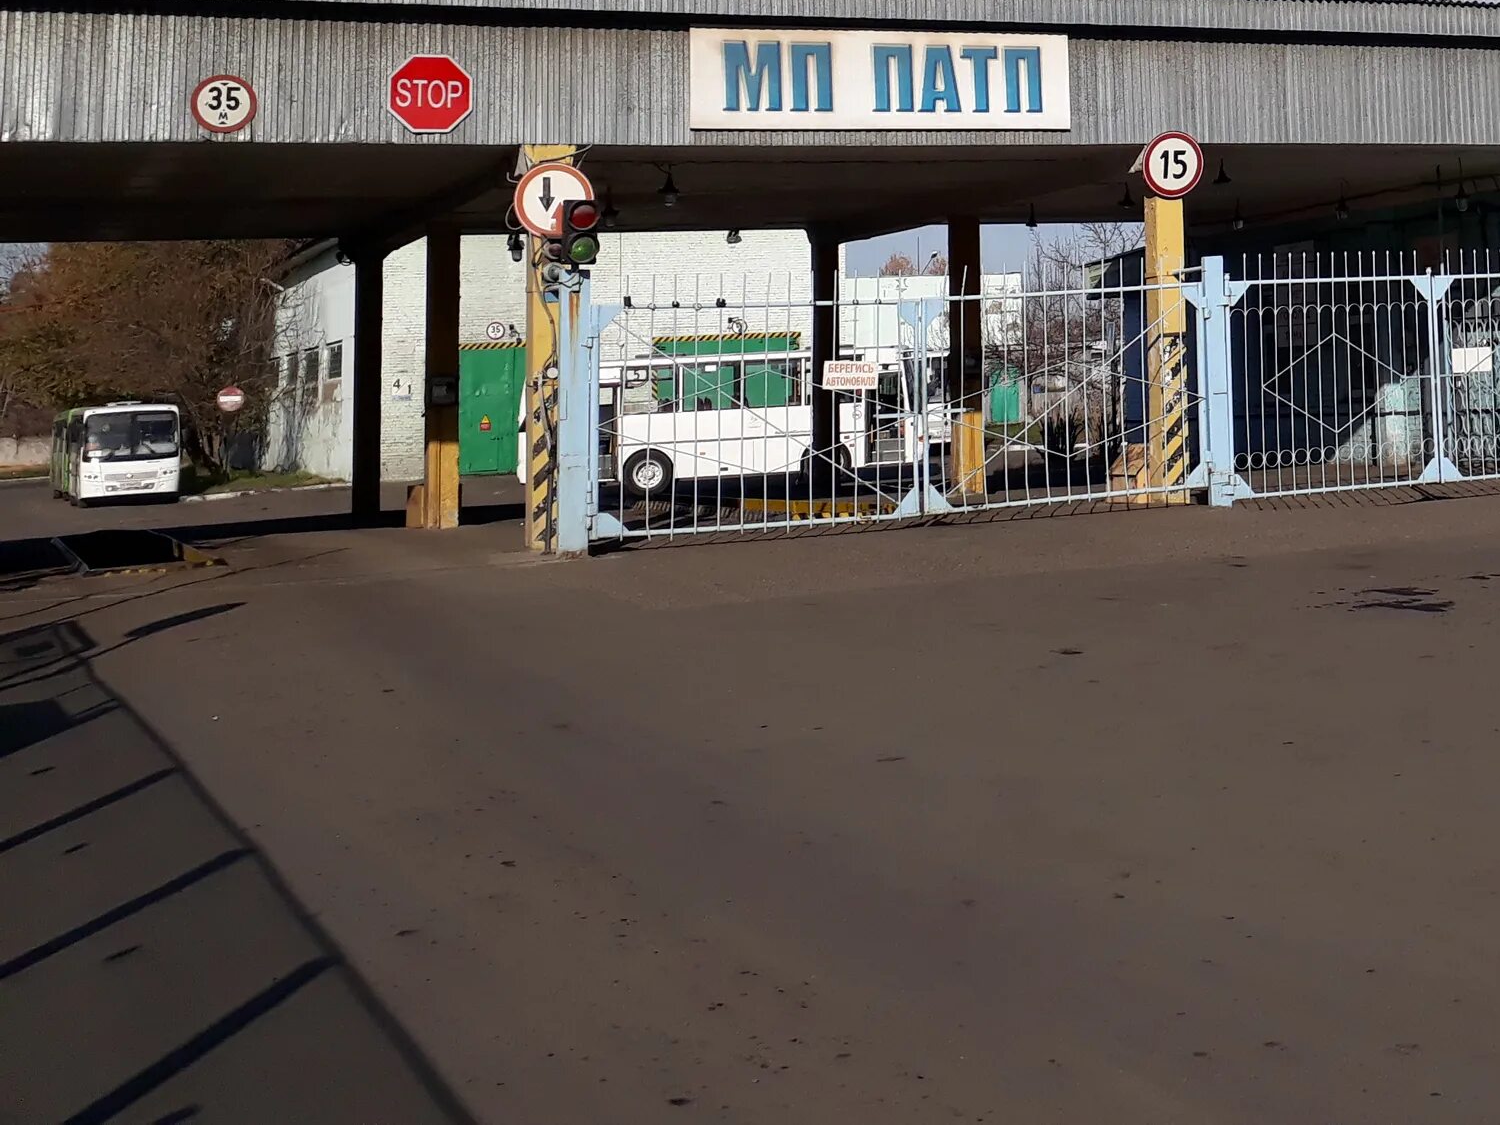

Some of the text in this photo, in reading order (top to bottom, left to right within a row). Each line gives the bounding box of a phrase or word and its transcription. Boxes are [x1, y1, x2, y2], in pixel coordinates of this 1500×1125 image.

[721, 39, 1043, 114] МП ПАТП
[208, 86, 241, 111] 35
[395, 78, 463, 109] STOP
[1159, 149, 1188, 180] 15
[825, 376, 876, 386] АВТОМОБИЛЯ
[828, 363, 874, 373] БЕРЕГИСЬ
